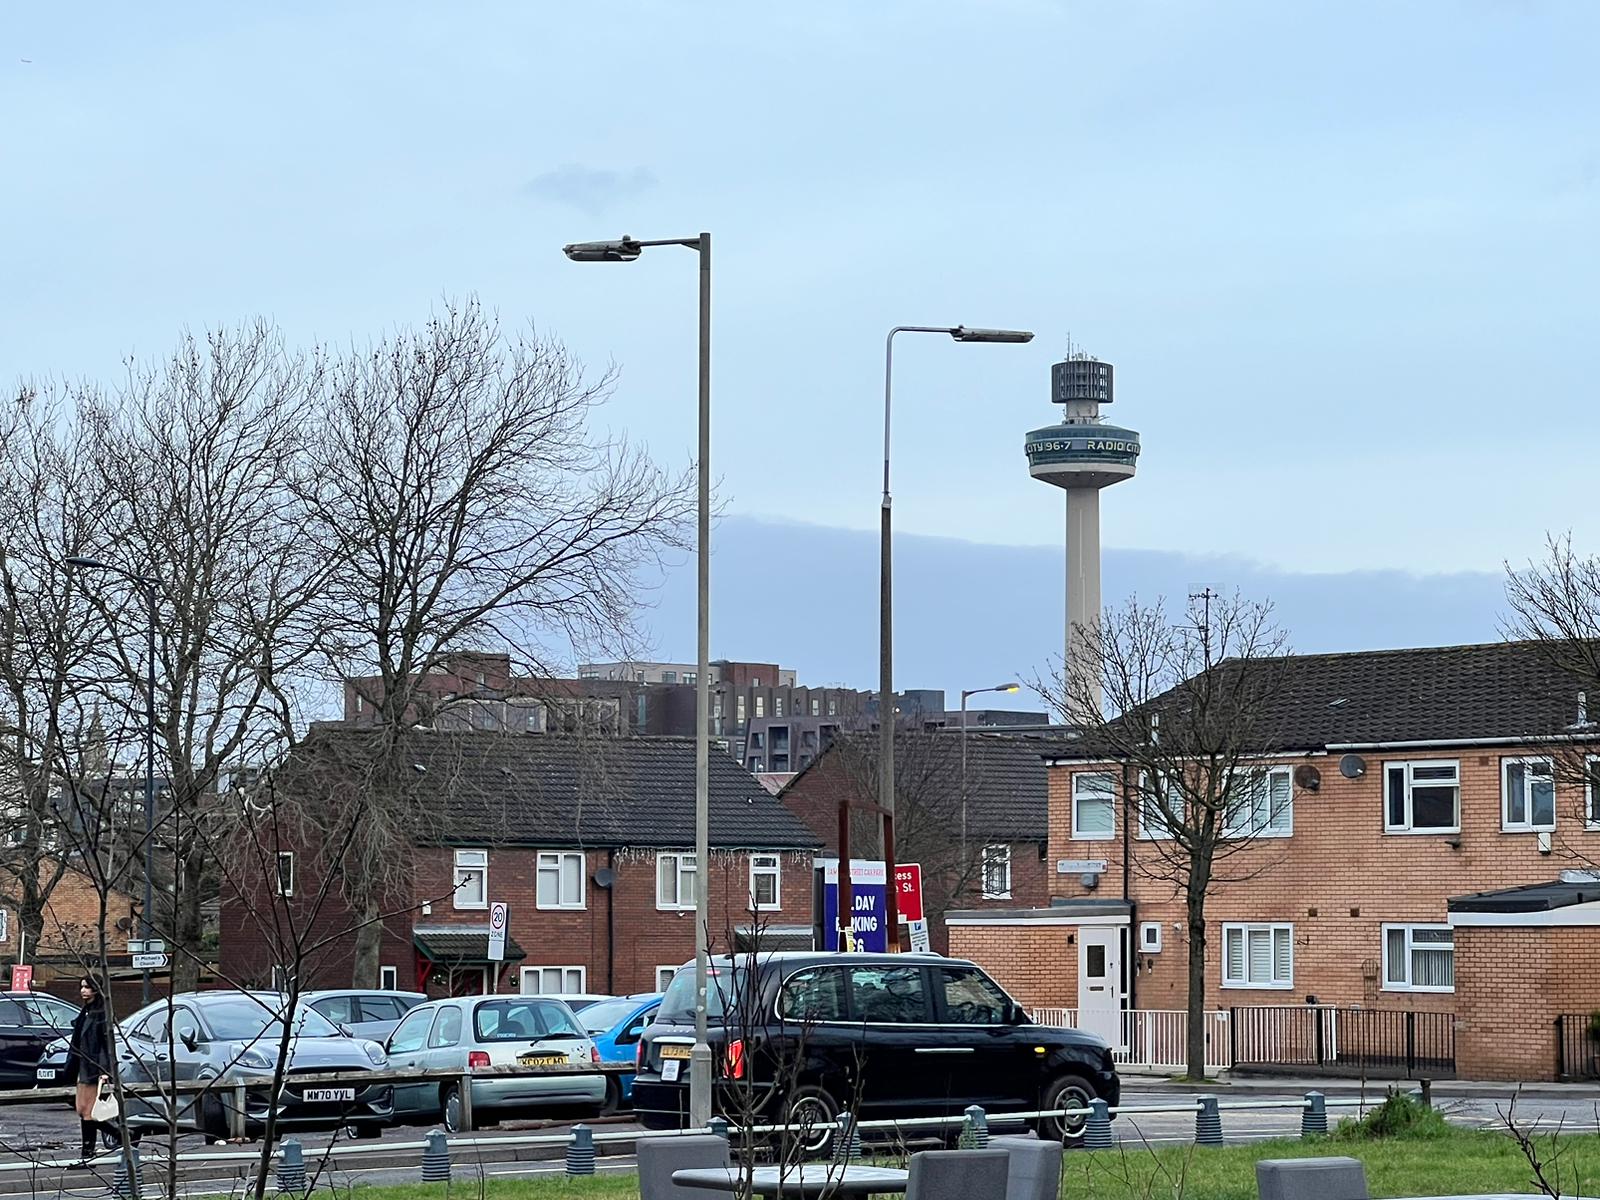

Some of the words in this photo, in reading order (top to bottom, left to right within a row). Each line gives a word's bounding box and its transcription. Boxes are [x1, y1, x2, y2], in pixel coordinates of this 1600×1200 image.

[1088, 440, 1124, 450] RADIO
[855, 895, 876, 911] DAY
[494, 911, 503, 922] 20
[835, 916, 878, 932] PRKING
[490, 930, 503, 939] ZONE
